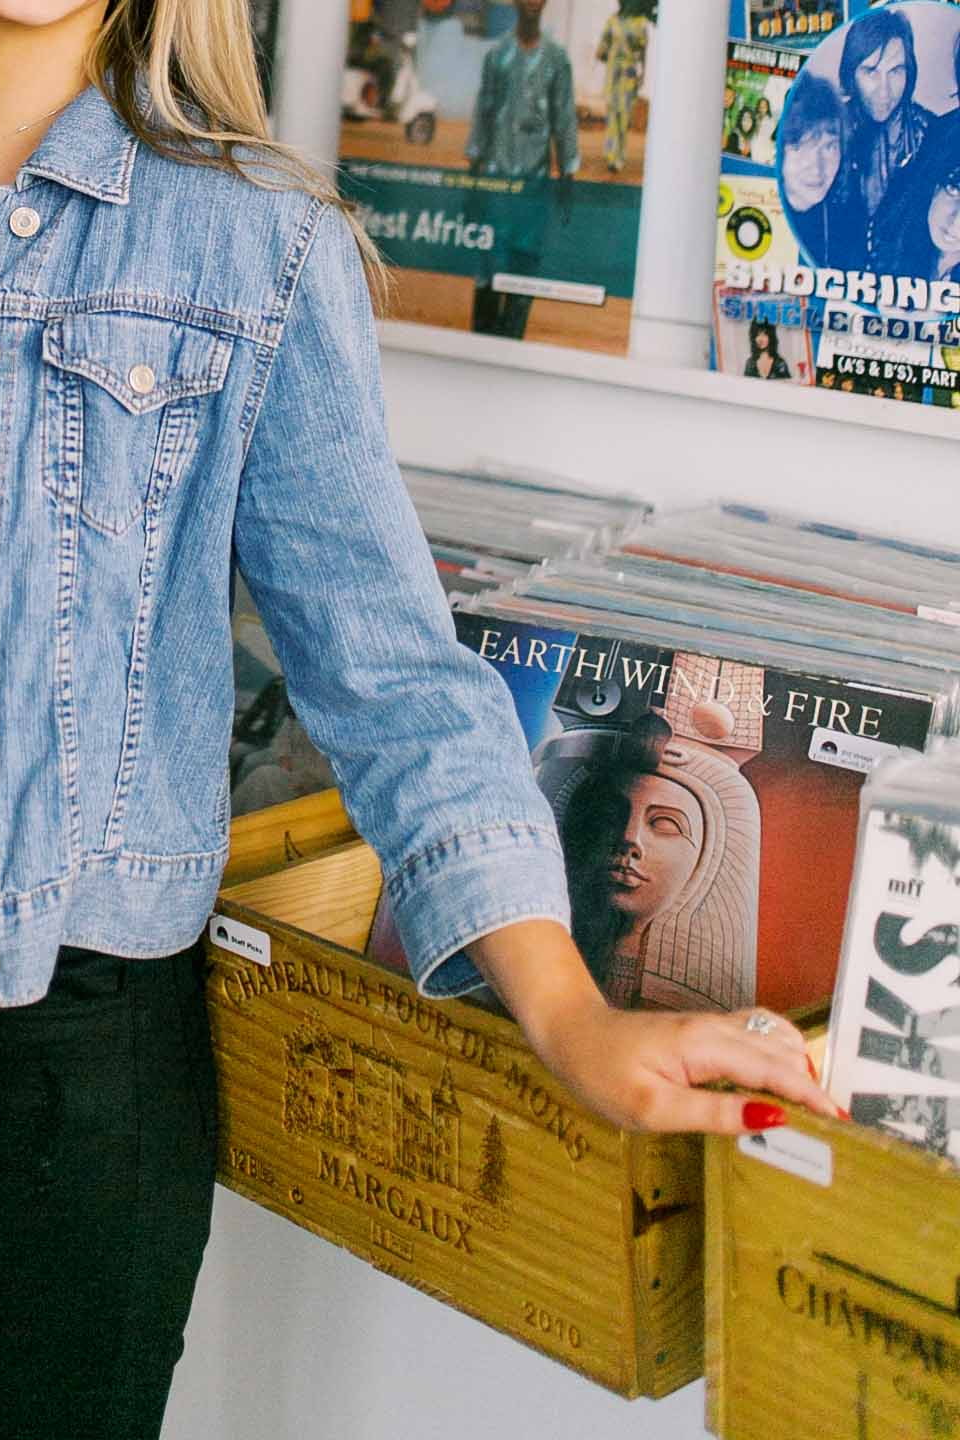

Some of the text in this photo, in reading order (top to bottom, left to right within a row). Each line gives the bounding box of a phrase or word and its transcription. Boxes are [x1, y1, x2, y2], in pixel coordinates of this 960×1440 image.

[411, 209, 495, 250] Africa
[726, 264, 960, 314] SHOCKING
[721, 295, 850, 333] SINGLE
[837, 356, 866, 377] (A'S
[868, 360, 881, 378] &
[922, 369, 958, 388] PART
[478, 629, 883, 739] EARTH WIND & FIRE
[231, 935, 263, 955] Staff Picks
[340, 968, 370, 1006] LA
[378, 982, 451, 1055] TOUR
[318, 1150, 473, 1255] MARGAUX
[520, 1301, 582, 1349] 2010
